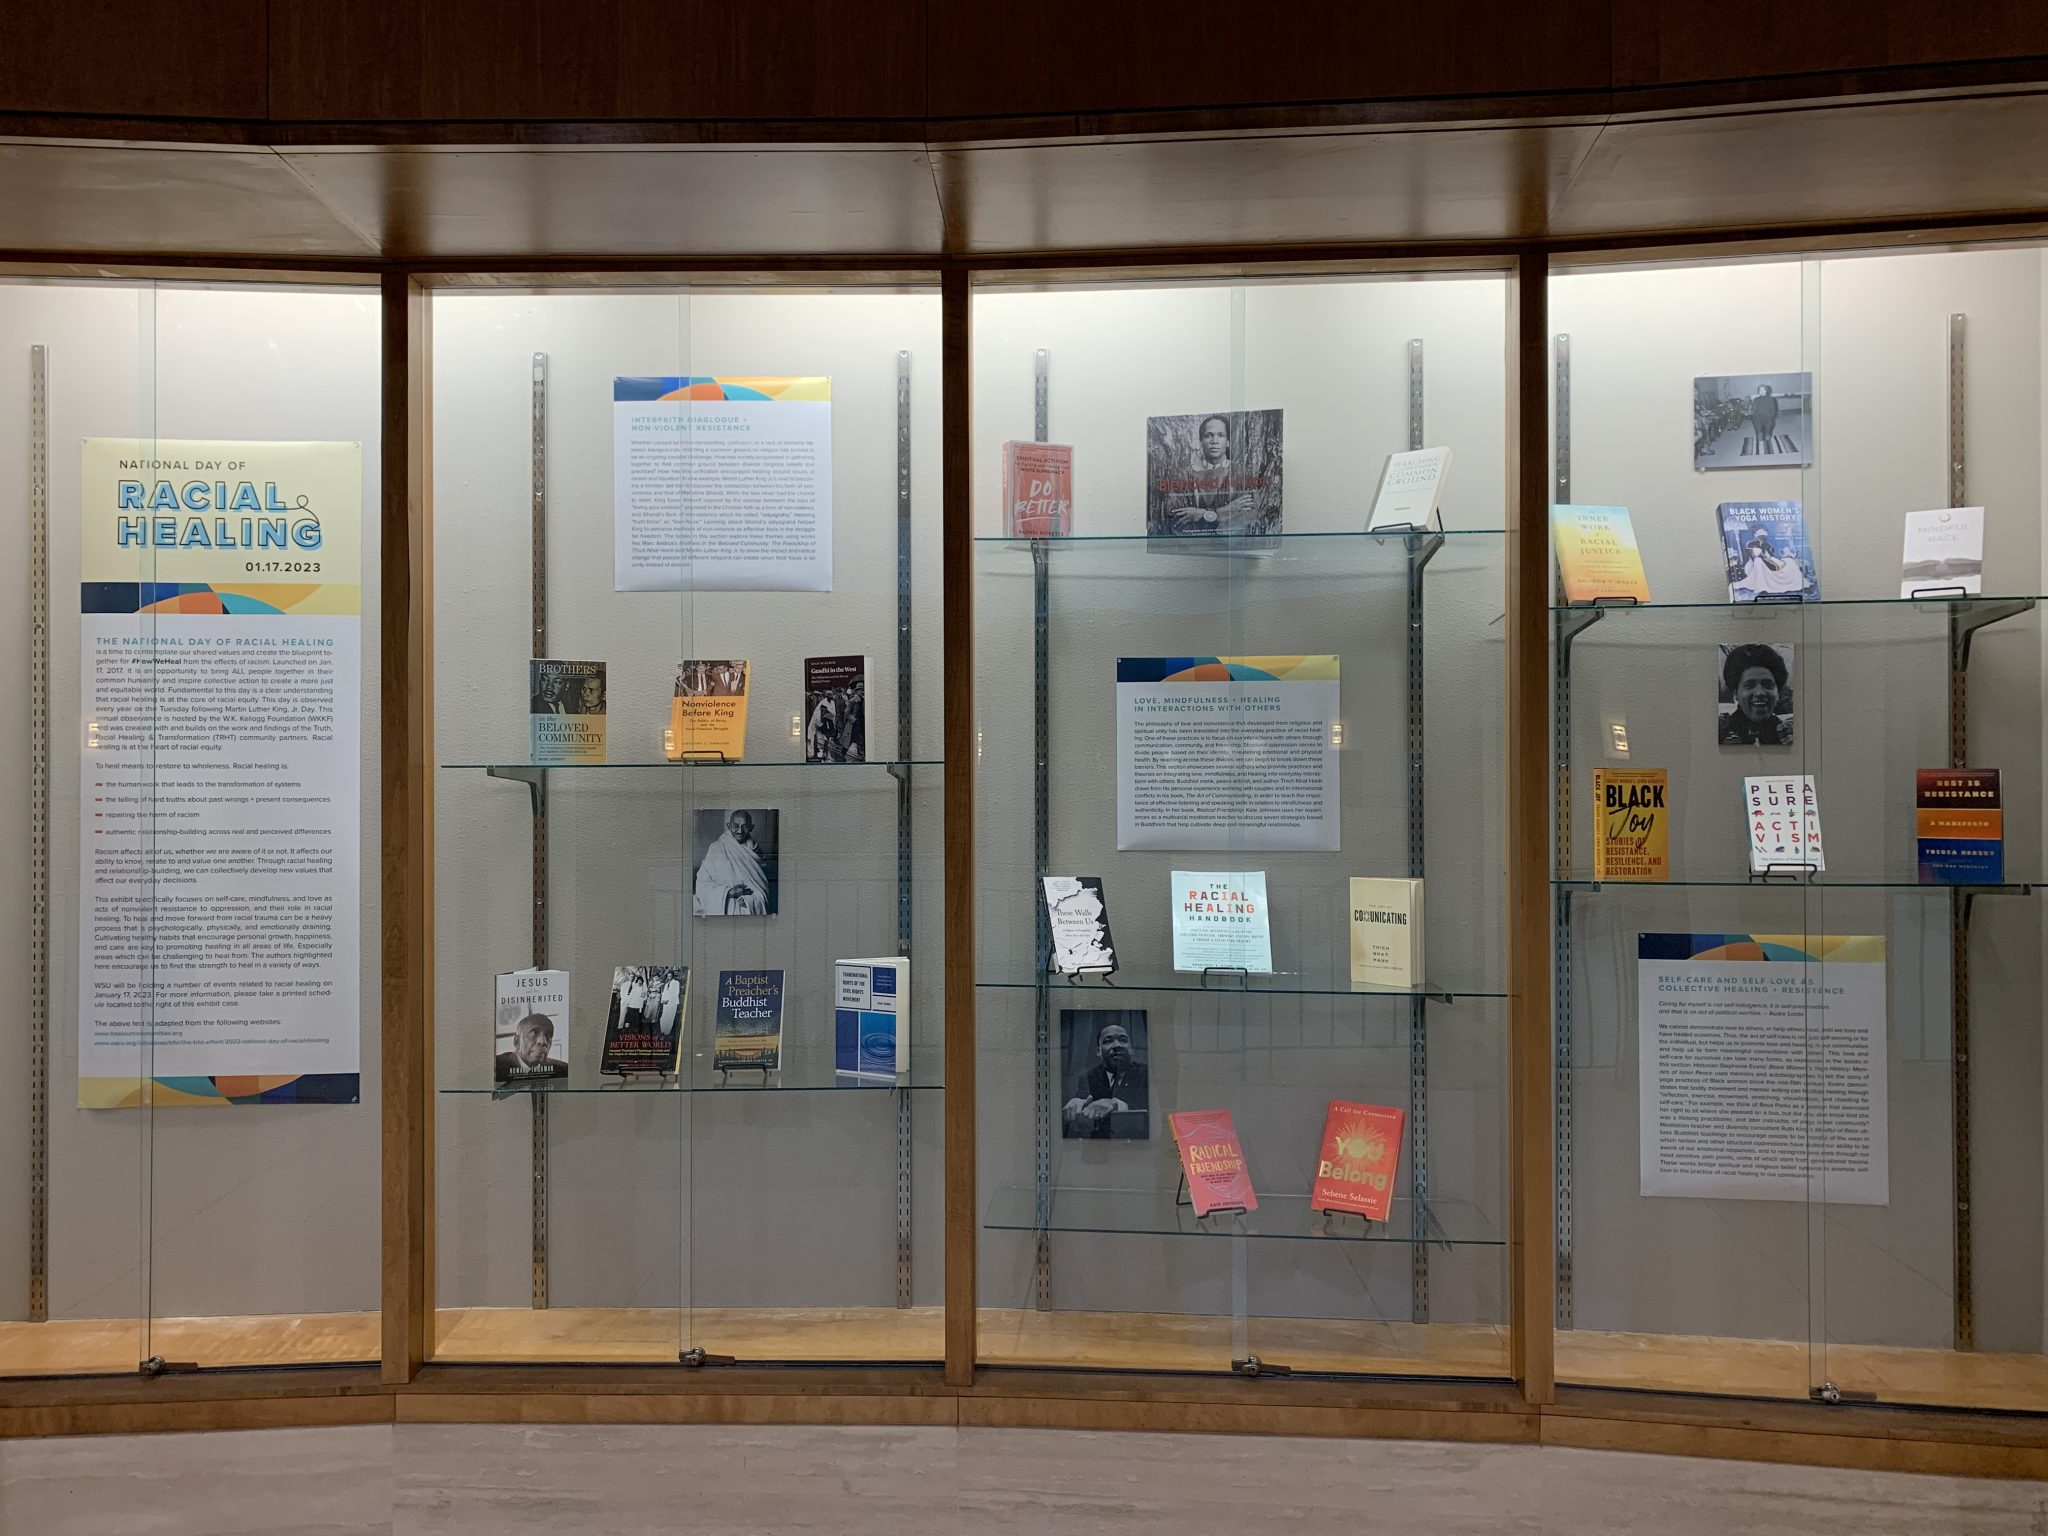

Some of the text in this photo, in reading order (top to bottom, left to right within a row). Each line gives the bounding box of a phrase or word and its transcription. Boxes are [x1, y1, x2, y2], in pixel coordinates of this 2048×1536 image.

[119, 460, 246, 471] NATIONAL DAY OF
[1387, 475, 1436, 486] GROUND
[1030, 480, 1052, 497] DO
[118, 480, 287, 512] RACIAL
[1015, 499, 1070, 515] BETTER
[117, 516, 323, 550] HEALING
[1918, 524, 1970, 533] MINDFUL
[1928, 535, 1960, 543] RACE
[245, 562, 321, 572] 01.17.2023
[122, 638, 184, 646] NATIONAL
[188, 638, 212, 646] DAY
[282, 638, 334, 646] HEALING
[539, 664, 596, 674] BROTHERS
[714, 709, 734, 718] King
[538, 722, 588, 732] BELOVED
[538, 734, 602, 742] COMMUNITY
[1606, 784, 1664, 808] BLACK
[1609, 802, 1654, 848] Joy
[1606, 837, 1634, 846] STORIES
[1606, 847, 1650, 856] RESISTANCE,
[1606, 857, 1662, 865] RESILIENCE, AND
[1606, 867, 1652, 876] RESTORATION
[1189, 891, 1248, 900] RACIAL
[1184, 902, 1254, 913] HEALING
[516, 978, 548, 987] JESUS
[725, 975, 768, 987] A Baptist
[728, 985, 778, 996] Preacher's
[1724, 986, 1768, 994] HEALING
[1782, 986, 1845, 994] RESISTANCE
[502, 994, 562, 1004] DISINHERITED
[722, 996, 767, 1008] Buddhist
[732, 1007, 772, 1018] Teacher
[1364, 1110, 1396, 1119] Connection
[1190, 1144, 1238, 1162] RADICAL
[1190, 1160, 1242, 1175] FRIENDSHIP
[1319, 1160, 1387, 1192] Belong
[1322, 1188, 1347, 1200] Sebene
[1350, 1193, 1378, 1204] Selassie
